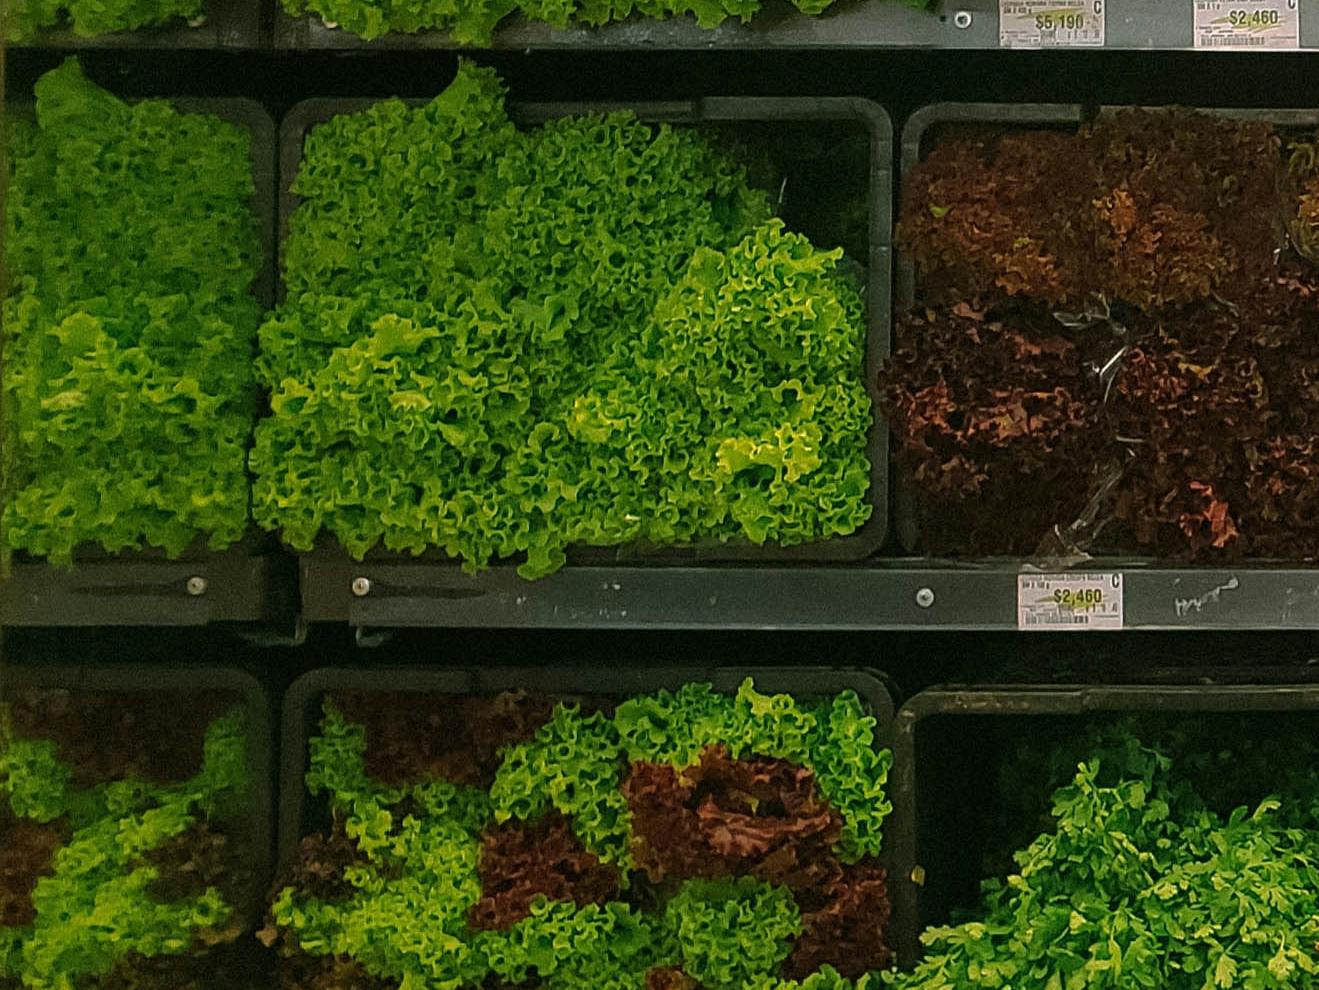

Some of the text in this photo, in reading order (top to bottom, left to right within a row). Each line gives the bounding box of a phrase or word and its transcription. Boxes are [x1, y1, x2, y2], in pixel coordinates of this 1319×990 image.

[1035, 14, 1084, 31] $5,190
[1229, 10, 1278, 27] $2,460
[1054, 588, 1102, 605] $2,460
